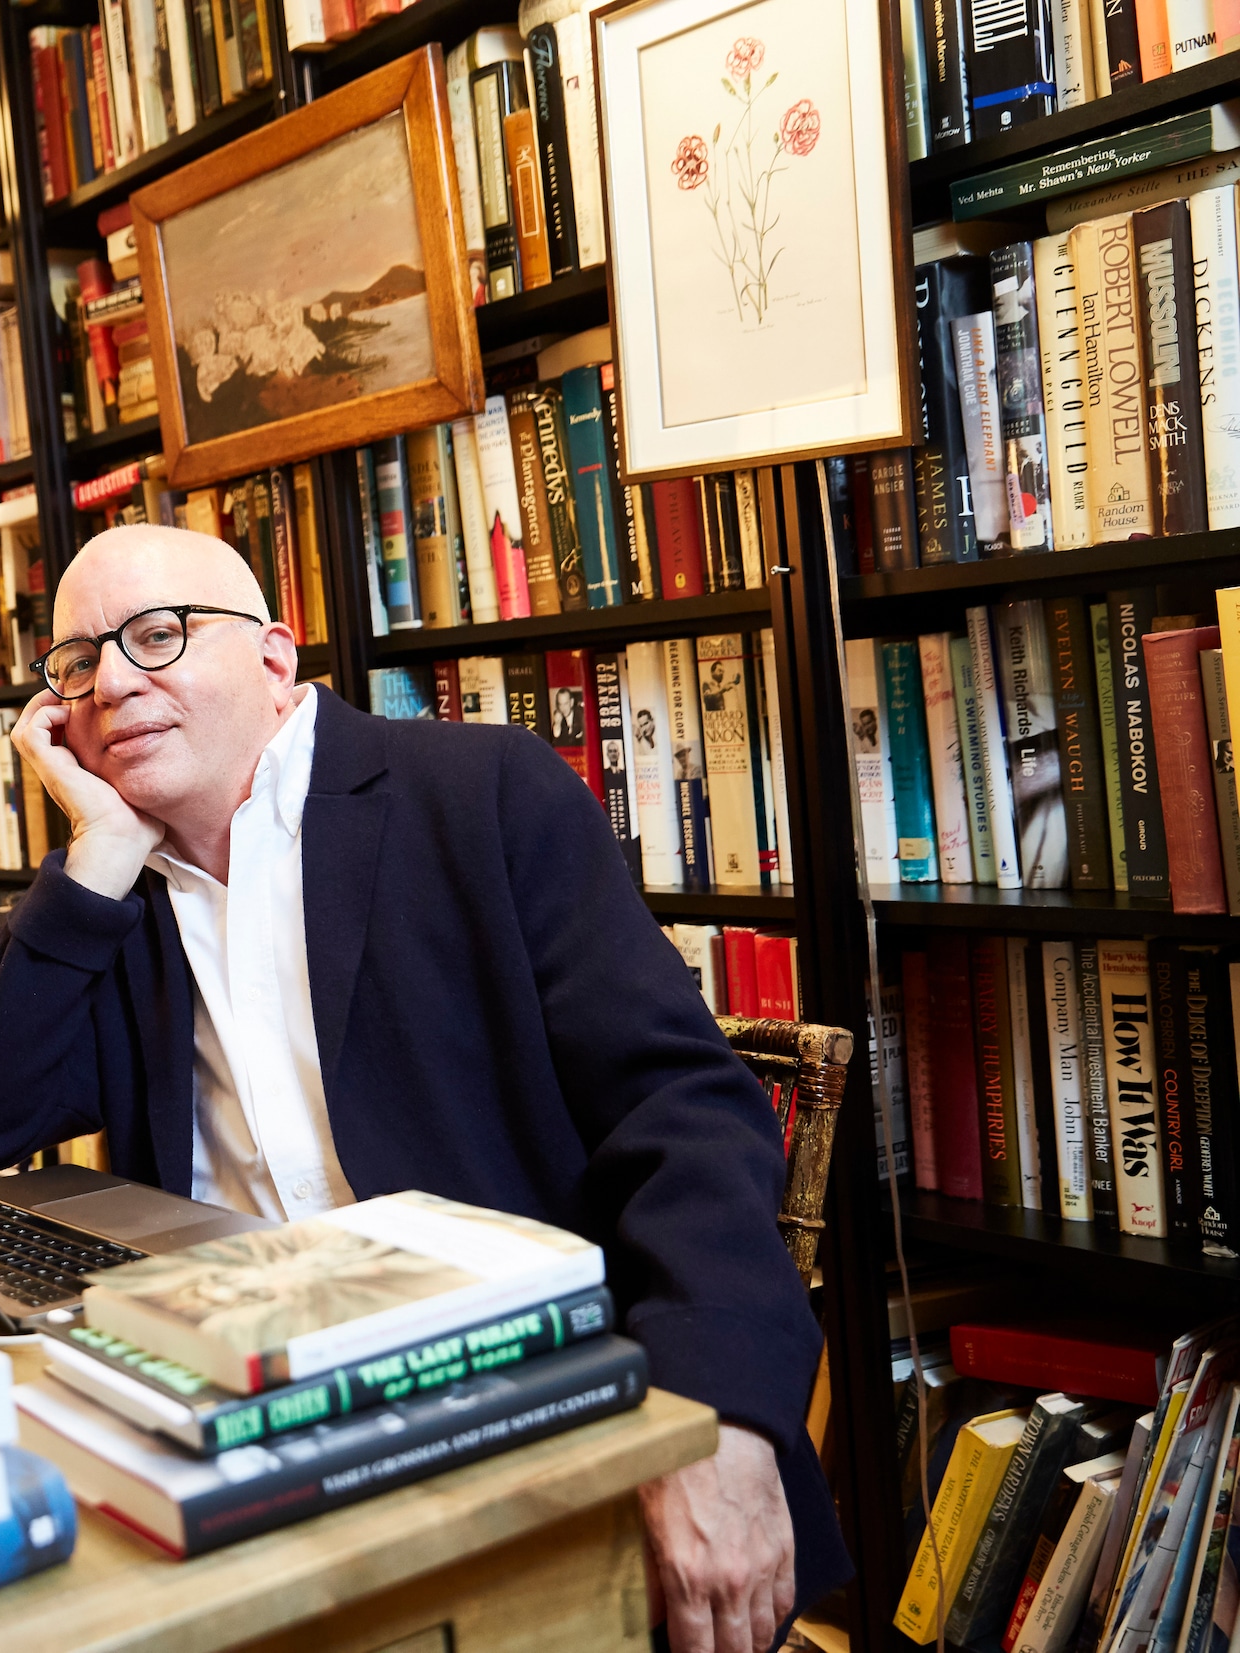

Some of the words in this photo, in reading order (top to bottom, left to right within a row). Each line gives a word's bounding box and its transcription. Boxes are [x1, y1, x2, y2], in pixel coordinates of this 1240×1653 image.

[937, 39, 946, 82] Moreau
[1175, 32, 1217, 55] PUTNAM
[531, 33, 554, 123] Florence
[546, 142, 559, 198] MICHAEL
[1018, 180, 1037, 196] Mr.
[1039, 168, 1083, 189] Shawn's
[1087, 162, 1111, 177] New
[1114, 150, 1152, 169] Yorker
[1042, 148, 1116, 176] Remembering
[958, 195, 974, 205] Ved
[976, 186, 1005, 201] Mehta
[1064, 190, 1123, 214] Alexander
[1128, 181, 1160, 197] Stille
[1174, 167, 1210, 184] THE
[1057, 243, 1069, 257] THE
[1099, 224, 1135, 335] ROBERT
[1053, 264, 1081, 362] GLENN
[1082, 290, 1099, 321] Ian
[1140, 238, 1181, 388] MUSSOLINI
[971, 328, 984, 354] LIKE
[1192, 257, 1216, 406] DICKENS
[1216, 276, 1238, 379] BECOMING
[957, 329, 974, 381] JONATHAN
[1084, 322, 1104, 408] Hamilton
[964, 382, 978, 405] COE
[976, 372, 989, 406] FIERY
[1107, 344, 1141, 466] LOWELL
[569, 406, 602, 426] Kennedy
[1060, 378, 1088, 474] GOULD
[1148, 415, 1188, 435] MACK
[1149, 401, 1180, 420] DENIS
[980, 411, 998, 472] ELEPHANT
[1149, 432, 1186, 451] SMITH
[78, 462, 139, 503] AUGUSTINE
[871, 463, 905, 481] CAROLE
[872, 481, 906, 496] ANGIER
[925, 453, 948, 529] JAMES
[520, 440, 542, 547] Plantagenets
[913, 459, 929, 532] ATLAS
[1072, 481, 1085, 510] READER
[1097, 502, 1145, 518] Random
[1102, 515, 1138, 528] House
[627, 519, 638, 563] YOUNG
[1009, 626, 1026, 664] Keith
[1120, 603, 1141, 689] NICOLAS
[382, 671, 416, 696] THE
[508, 666, 534, 676] ISRAEL
[668, 641, 682, 688] REACHING
[981, 653, 995, 691] OGILVY
[1213, 656, 1224, 694] STEPHEN
[384, 696, 423, 720] MAN
[595, 663, 611, 729] CHARGE
[604, 661, 622, 728] TAKING
[673, 689, 683, 709] FOR
[1013, 668, 1033, 736] Richards
[1054, 608, 1076, 690] EVELYN
[1065, 711, 1086, 793] WAUGH
[674, 711, 686, 741] GLORY
[703, 710, 745, 723] RICHARD
[965, 697, 982, 771] SWIMMING
[1216, 696, 1228, 734] SPENDER
[704, 728, 746, 744] NIXON
[1126, 699, 1149, 795] NABOKOV
[1020, 748, 1038, 778] Life
[679, 780, 691, 817] MICHAEL
[972, 776, 988, 833] STUDIES
[682, 818, 696, 866] BESCHLOSS
[1137, 819, 1147, 851] GIROUD
[1132, 874, 1163, 882] OXFORD
[1081, 947, 1097, 969] The
[1102, 951, 1124, 964] Mary
[1051, 957, 1072, 1037] Company
[1157, 962, 1173, 1000] EDNA
[1187, 968, 1201, 993] THE
[1082, 972, 1102, 1039] Accidental
[1186, 994, 1208, 1040] DUKE
[1110, 992, 1149, 1075] How
[1059, 1043, 1079, 1081] Man
[1190, 1043, 1209, 1064] OF
[1087, 1042, 1106, 1114] Investment
[982, 1044, 1008, 1161] HUMPHRIES
[1063, 1097, 1082, 1134] John
[1163, 1069, 1182, 1139] COUNTRY
[1191, 1066, 1213, 1136] DECEPTION
[1092, 1118, 1110, 1164] Banker
[1120, 1110, 1158, 1179] Was
[1168, 1141, 1184, 1173] GIRL
[1131, 1216, 1158, 1229] Knopf
[1198, 1216, 1228, 1230] Random
[1200, 1226, 1225, 1238] House
[358, 1354, 407, 1388] THE
[407, 1336, 464, 1374] LAST
[465, 1312, 544, 1354] PIRATE
[1017, 1415, 1045, 1460] TOWN
[992, 1458, 1028, 1522] GARDENS
[1082, 1494, 1103, 1526] English
